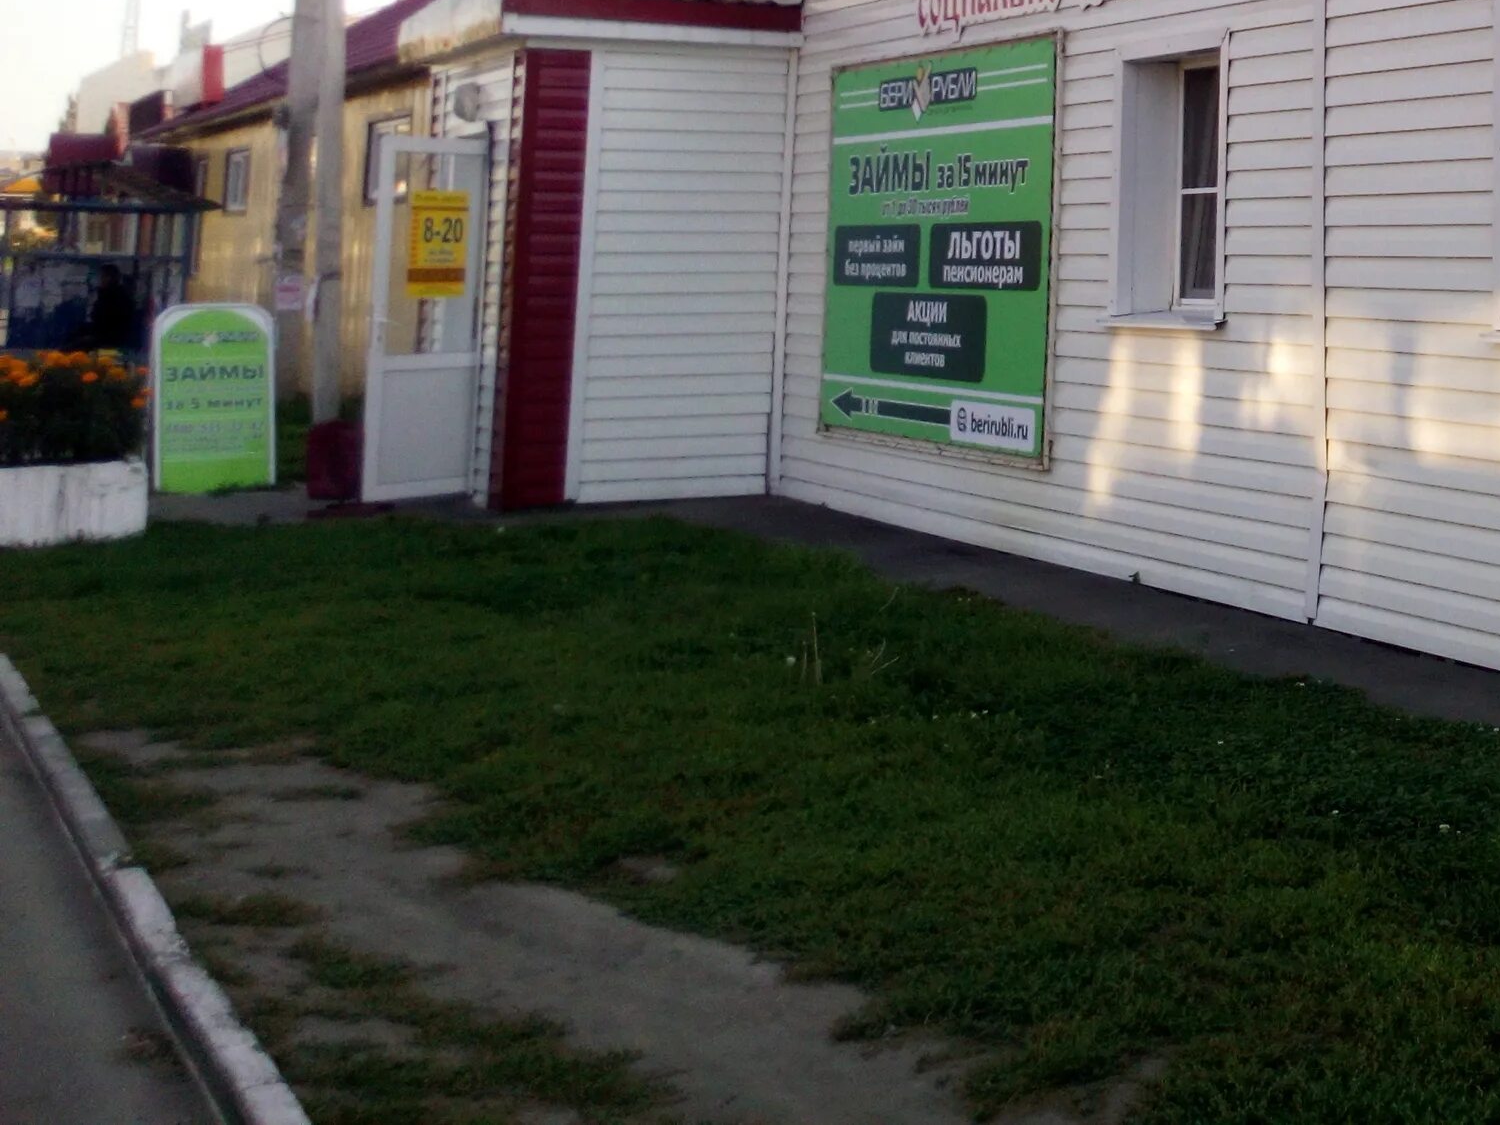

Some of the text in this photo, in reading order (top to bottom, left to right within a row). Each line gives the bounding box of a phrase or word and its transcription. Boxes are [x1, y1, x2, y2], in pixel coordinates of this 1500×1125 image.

[880, 71, 976, 108] БЕРИ РУБЛИ
[849, 144, 1029, 194] ЗАЙМЫ за 15 минут
[424, 217, 463, 243] 8-20
[848, 235, 881, 256] первый
[948, 230, 1021, 260] ЛЬГОТЫ
[860, 262, 907, 279] процентов
[943, 265, 1023, 288] пенсионерам
[907, 300, 948, 326] АКЦИИ
[891, 330, 961, 348] для постоянных
[904, 351, 945, 368] клиентов
[165, 362, 264, 382] ЗАЙМЫ
[971, 412, 1029, 441] berirubli.ru
